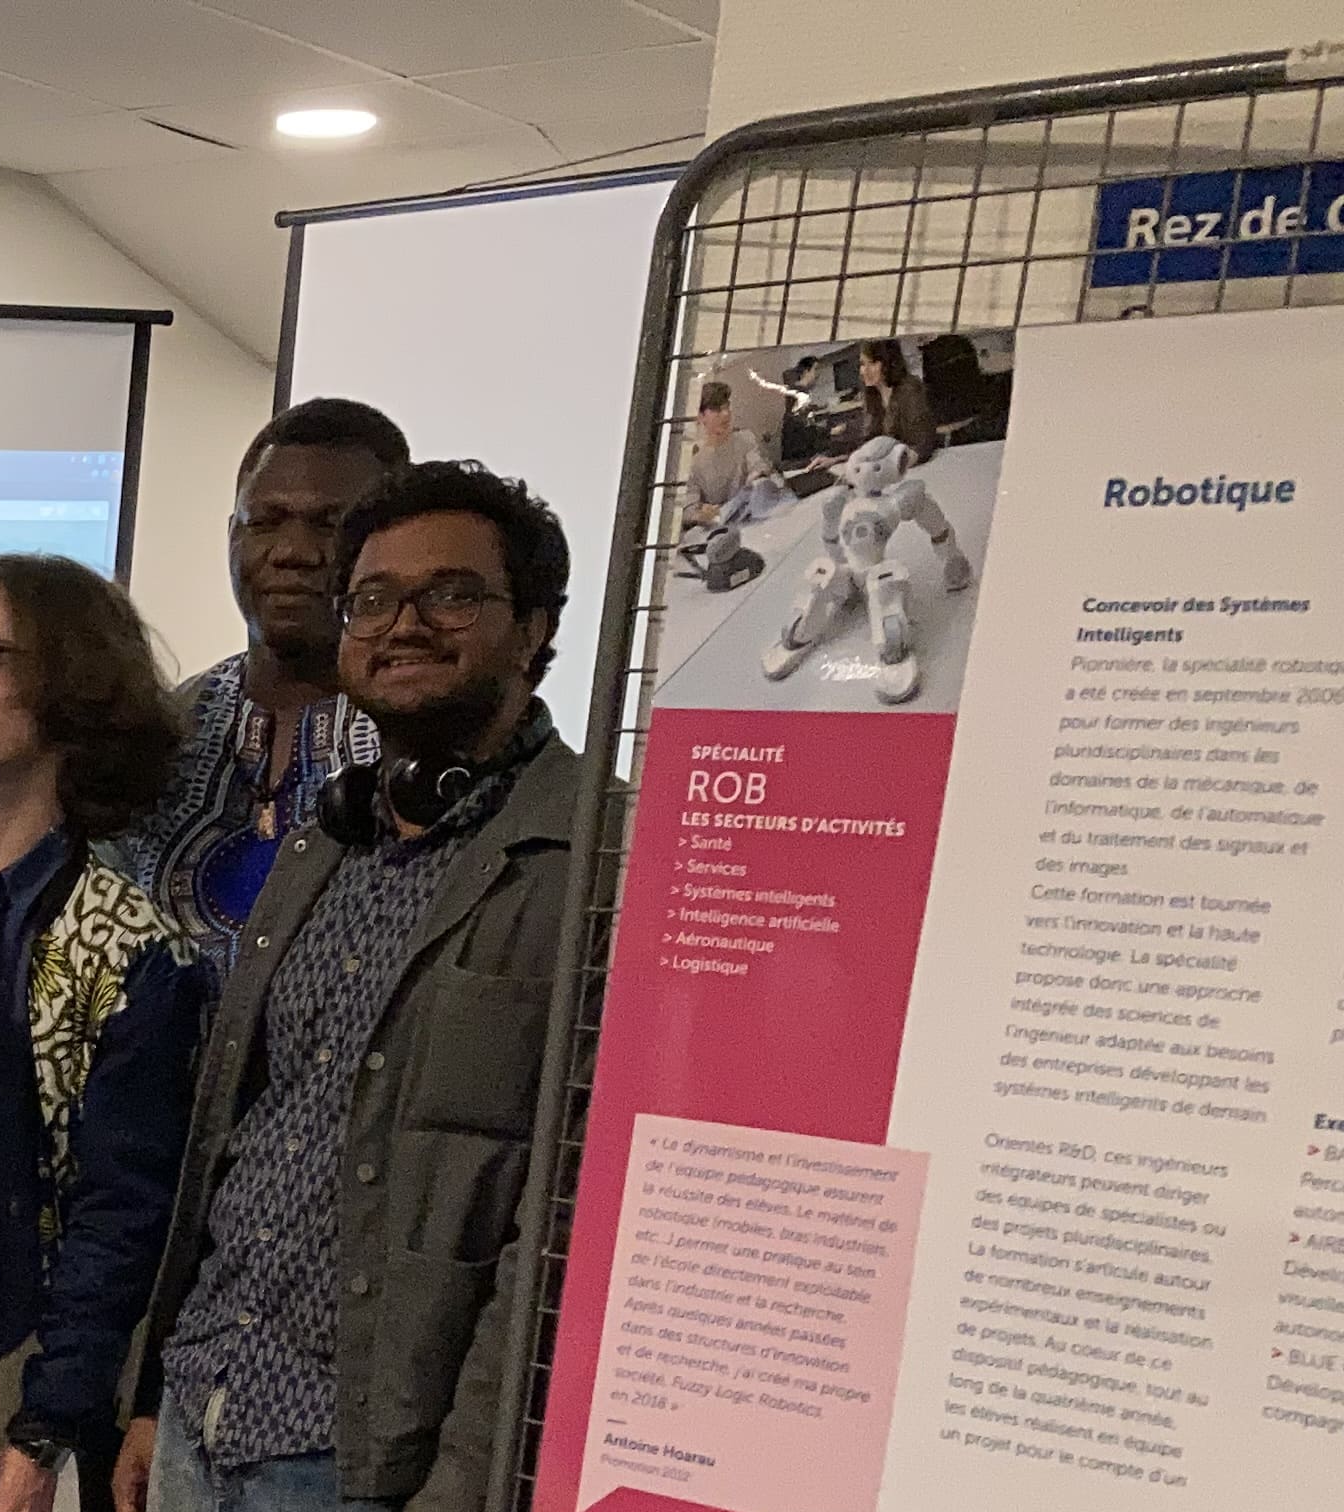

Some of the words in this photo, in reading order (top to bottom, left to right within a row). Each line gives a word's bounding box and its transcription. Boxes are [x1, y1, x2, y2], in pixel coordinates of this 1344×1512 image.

[1127, 208, 1222, 248] Rez
[1239, 195, 1307, 238] de
[1104, 472, 1295, 511] Robotique
[1083, 598, 1178, 613] Concevoir
[1181, 598, 1214, 611] des
[1220, 596, 1310, 616] Systèmes
[1077, 628, 1184, 645] Intelligents
[1162, 657, 1178, 672] la
[1065, 687, 1074, 700] a
[1166, 688, 1187, 700] en
[1059, 718, 1099, 733] pour
[1105, 715, 1165, 730] former
[1168, 717, 1200, 731] des
[692, 745, 784, 762] SPÉCIALITÉ
[688, 771, 767, 804] ROB
[1137, 775, 1159, 790] de
[1164, 776, 1177, 791] la
[682, 812, 710, 826] LES
[714, 814, 797, 831] SECTEURS
[1171, 805, 1194, 820] de
[690, 834, 732, 851] Santé
[1062, 830, 1082, 844] du
[1180, 835, 1212, 850] des
[686, 859, 747, 876] Services
[1035, 856, 1064, 873] des
[684, 883, 752, 902] Systèmes
[756, 890, 836, 909] intelligents
[1031, 884, 1076, 901] Cette
[1081, 888, 1165, 906] formation
[680, 908, 765, 928] Intelligence
[676, 932, 774, 954] Aéronautique
[673, 956, 748, 976] Logistique
[1083, 1003, 1112, 1020] des
[604, 1433, 659, 1455] Antoine
